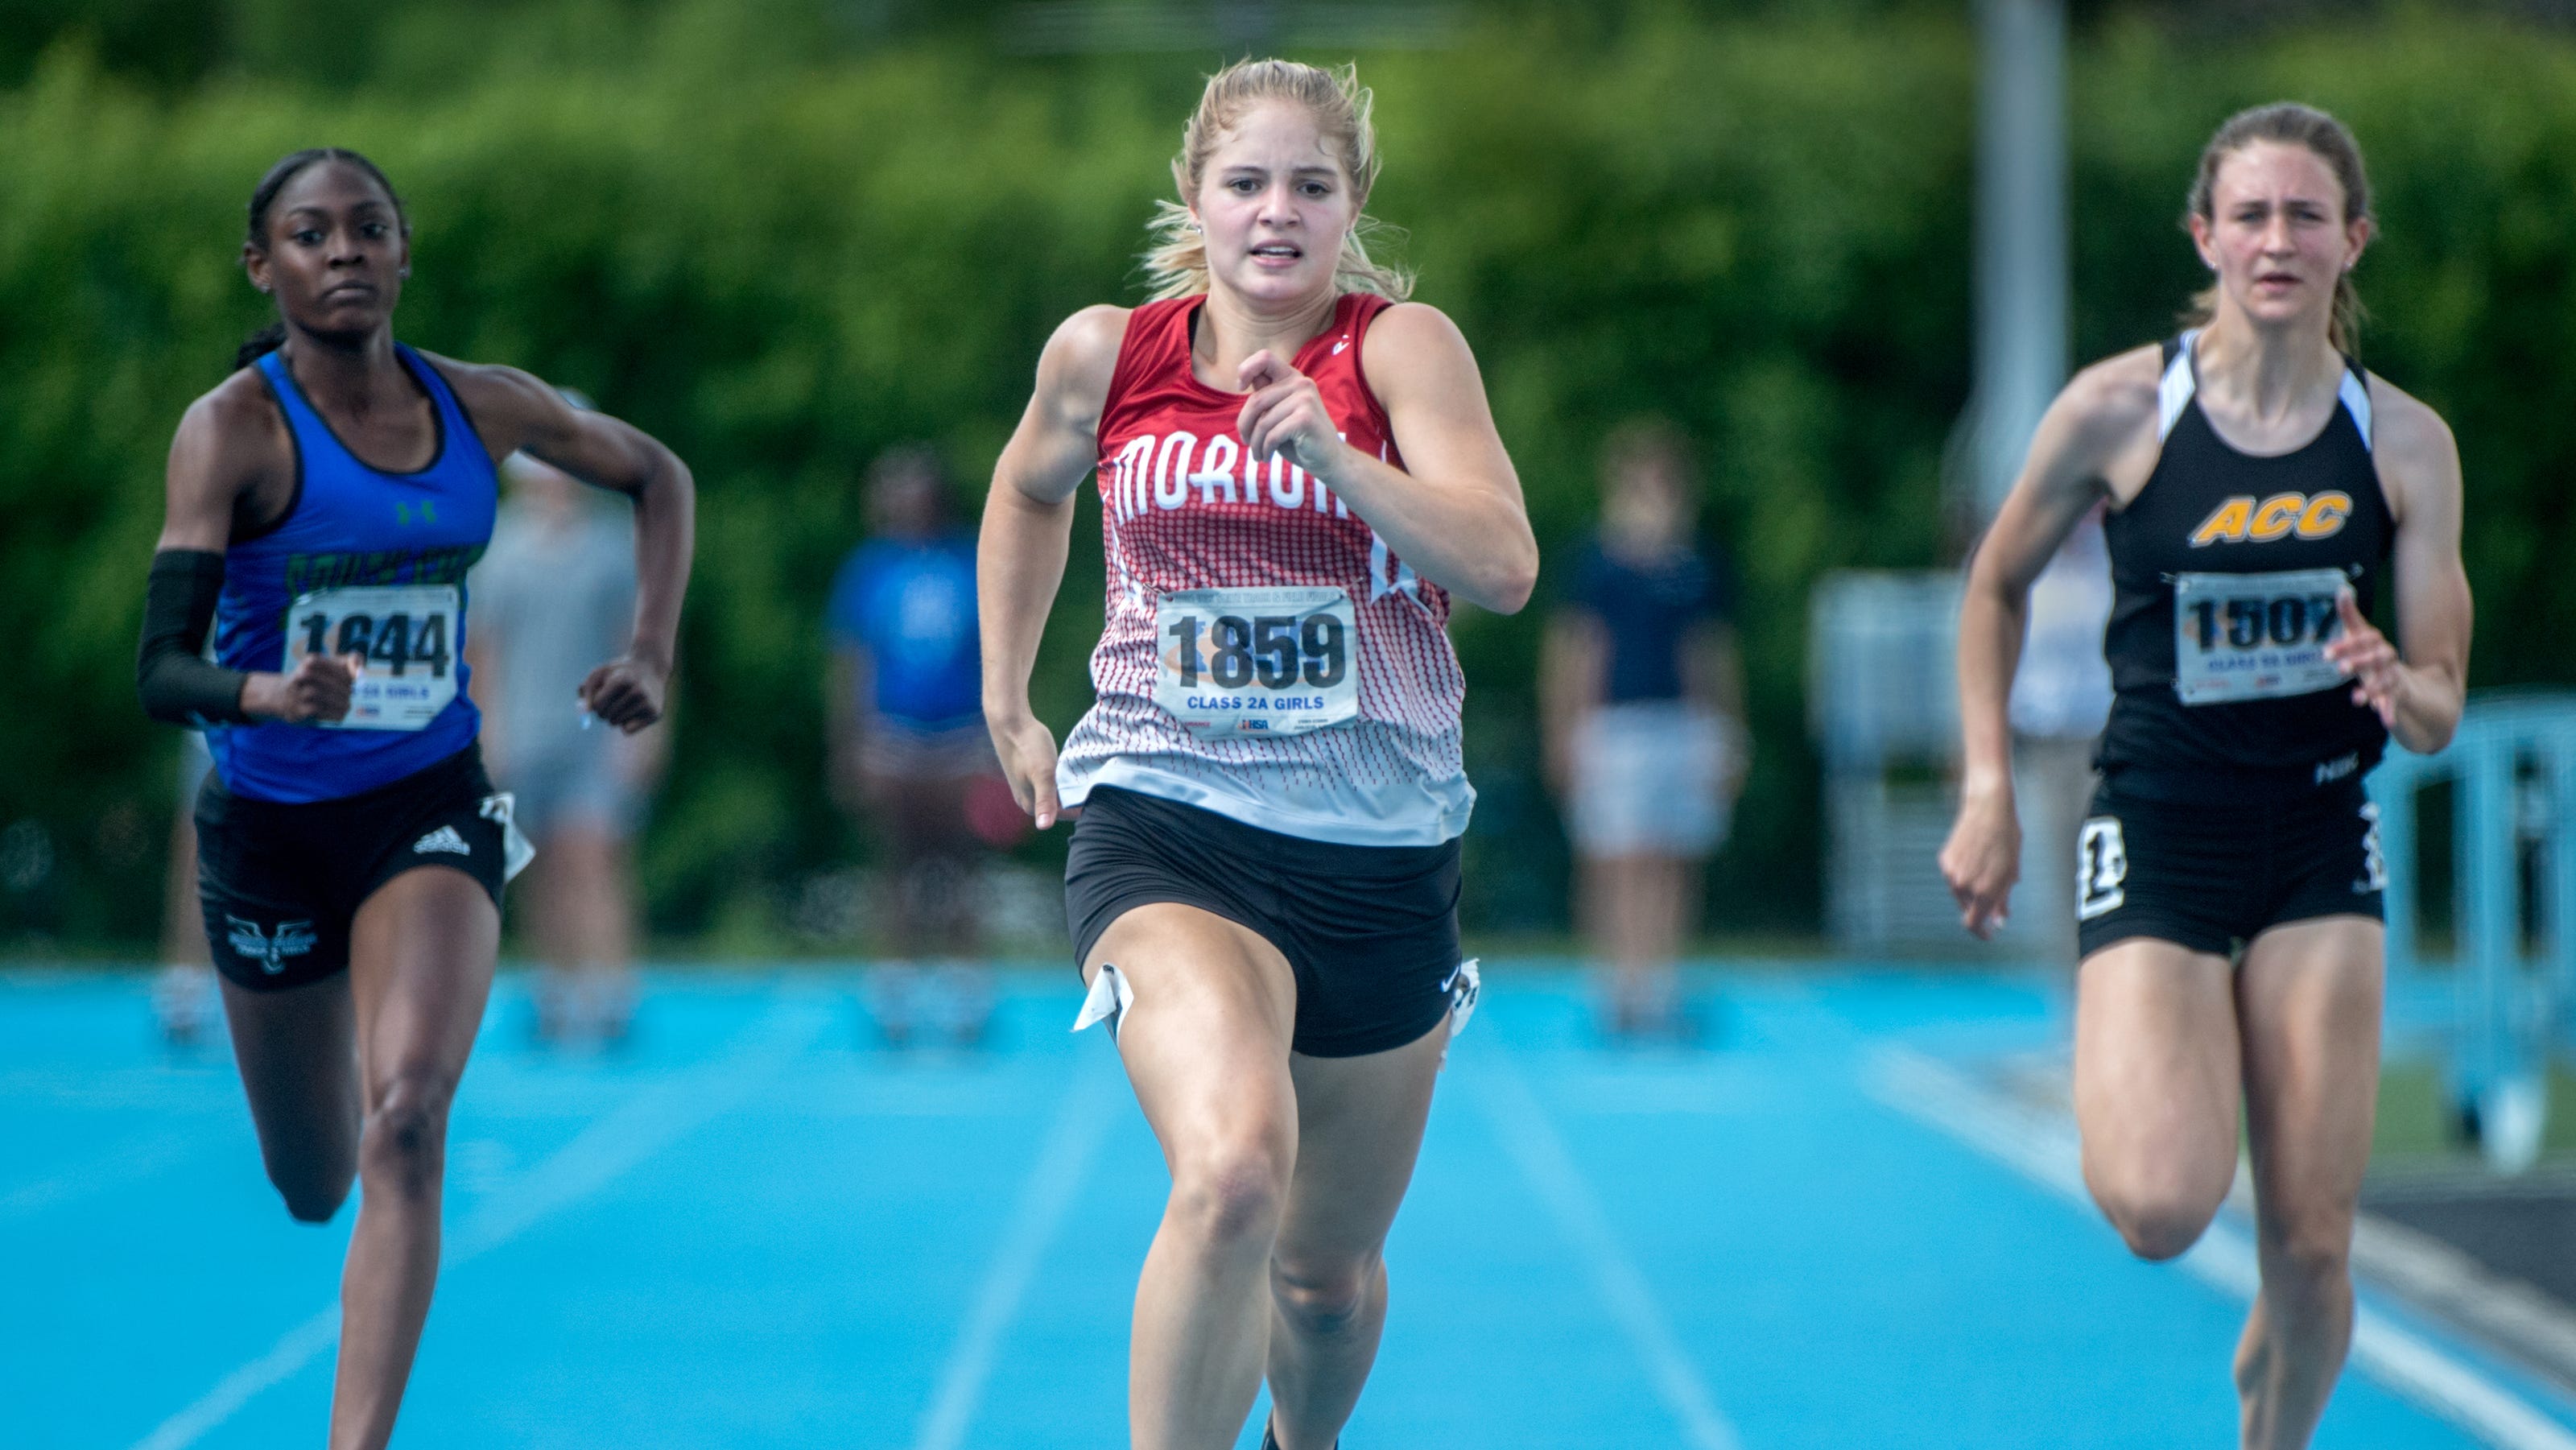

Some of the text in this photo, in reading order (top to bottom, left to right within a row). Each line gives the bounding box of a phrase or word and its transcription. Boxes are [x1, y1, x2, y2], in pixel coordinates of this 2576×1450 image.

[2186, 490, 2354, 548] ACC
[299, 611, 449, 679] 1644
[1169, 613, 1347, 690] 1859
[2188, 595, 2338, 654] 1507
[1187, 696, 1324, 710] CLASS 2A GIRLS
